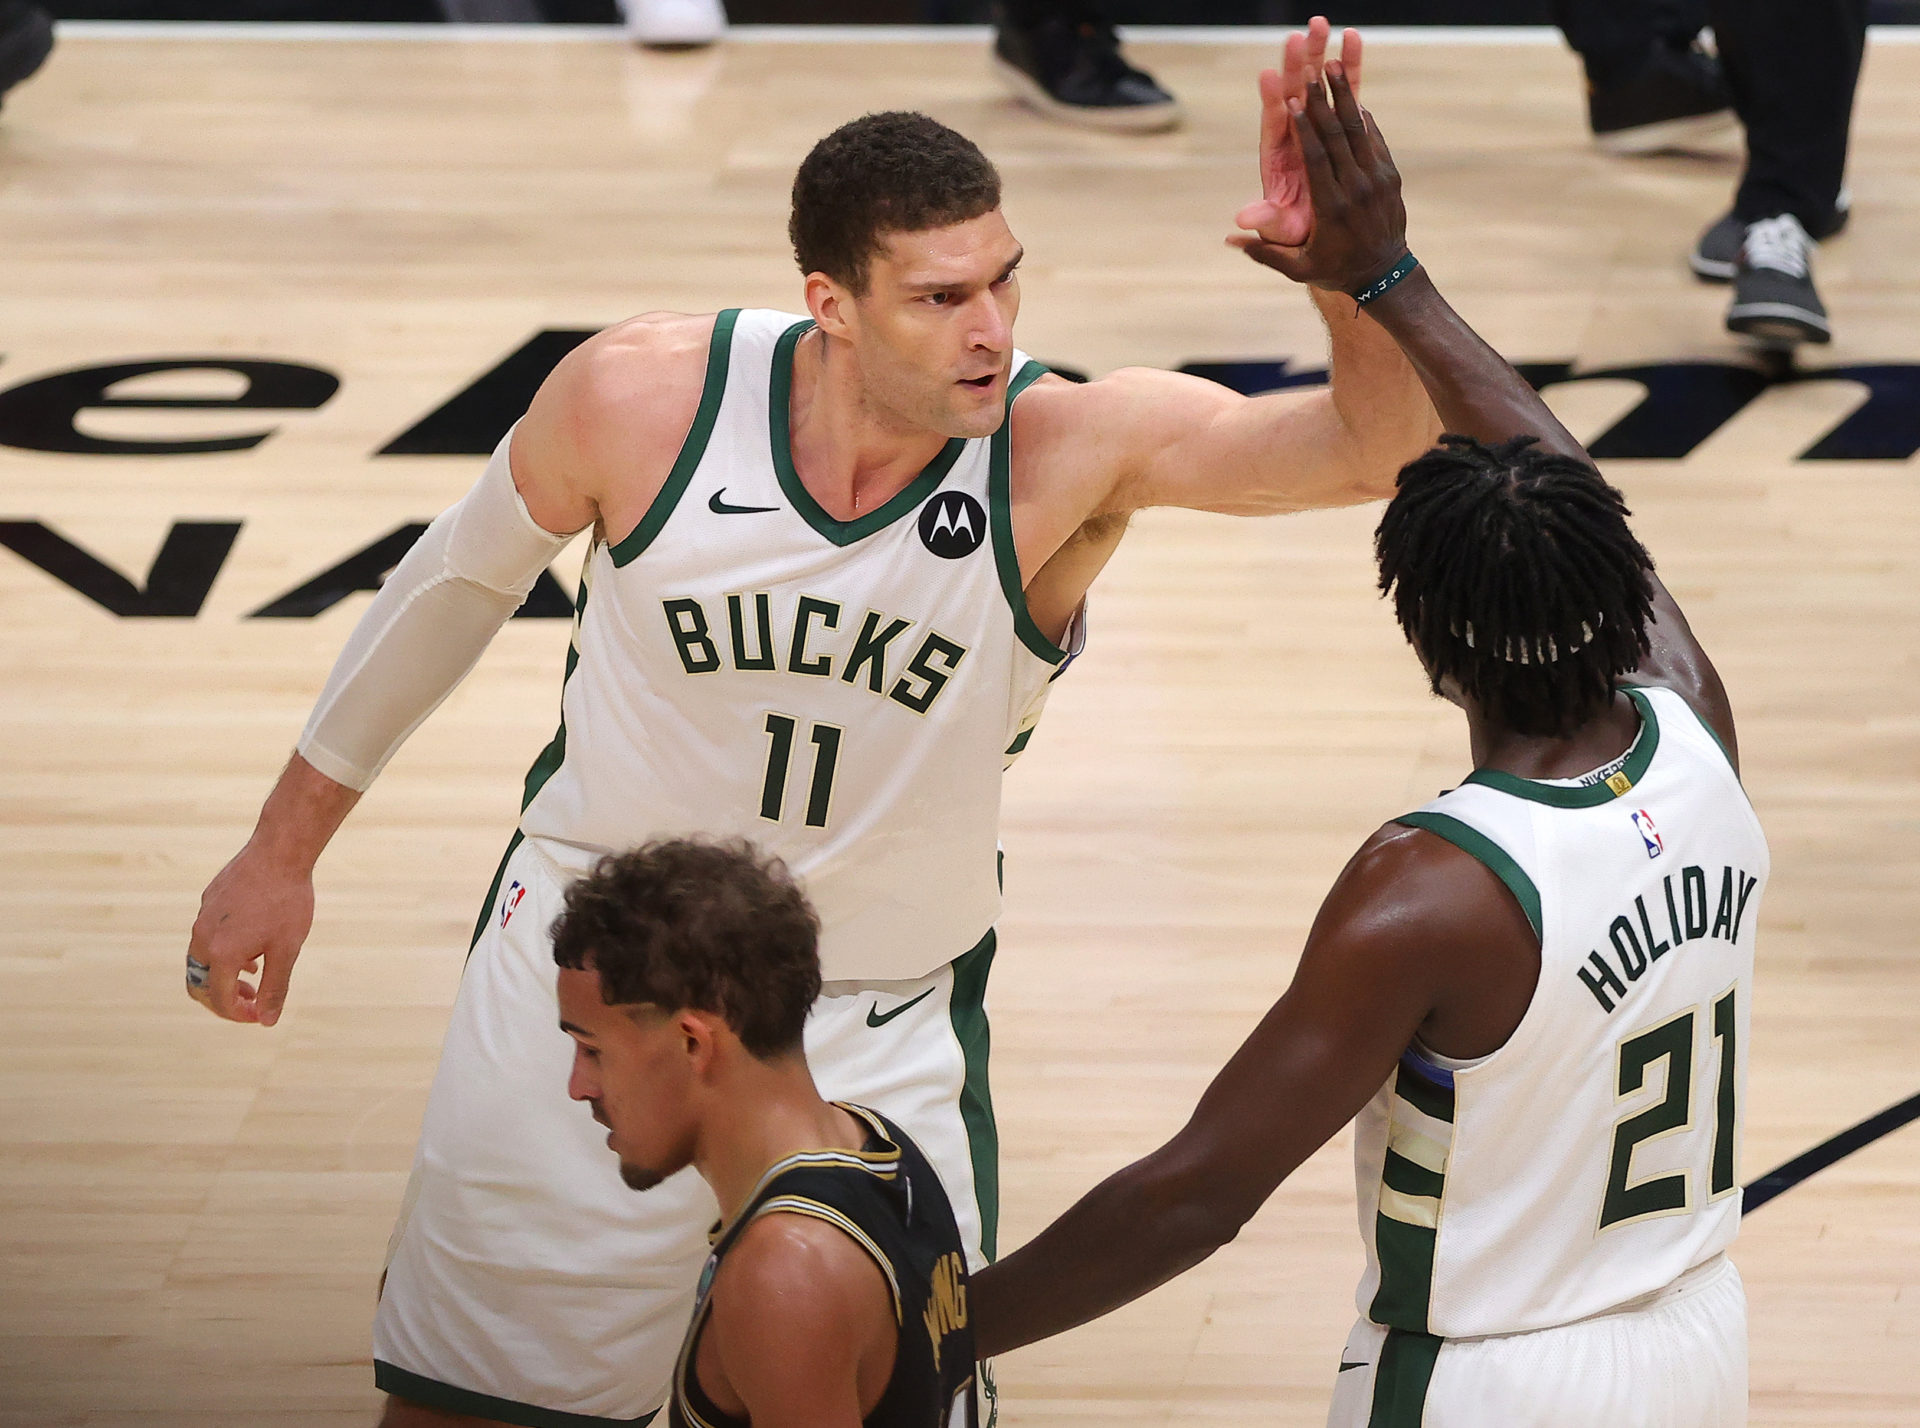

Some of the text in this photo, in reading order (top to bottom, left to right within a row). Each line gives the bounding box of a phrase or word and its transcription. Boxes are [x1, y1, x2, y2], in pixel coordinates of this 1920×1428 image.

[660, 591, 970, 717] BUCKS
[760, 710, 846, 830] 11
[1577, 865, 1757, 1014] HOLIDAY
[1594, 979, 1738, 1238] 21
